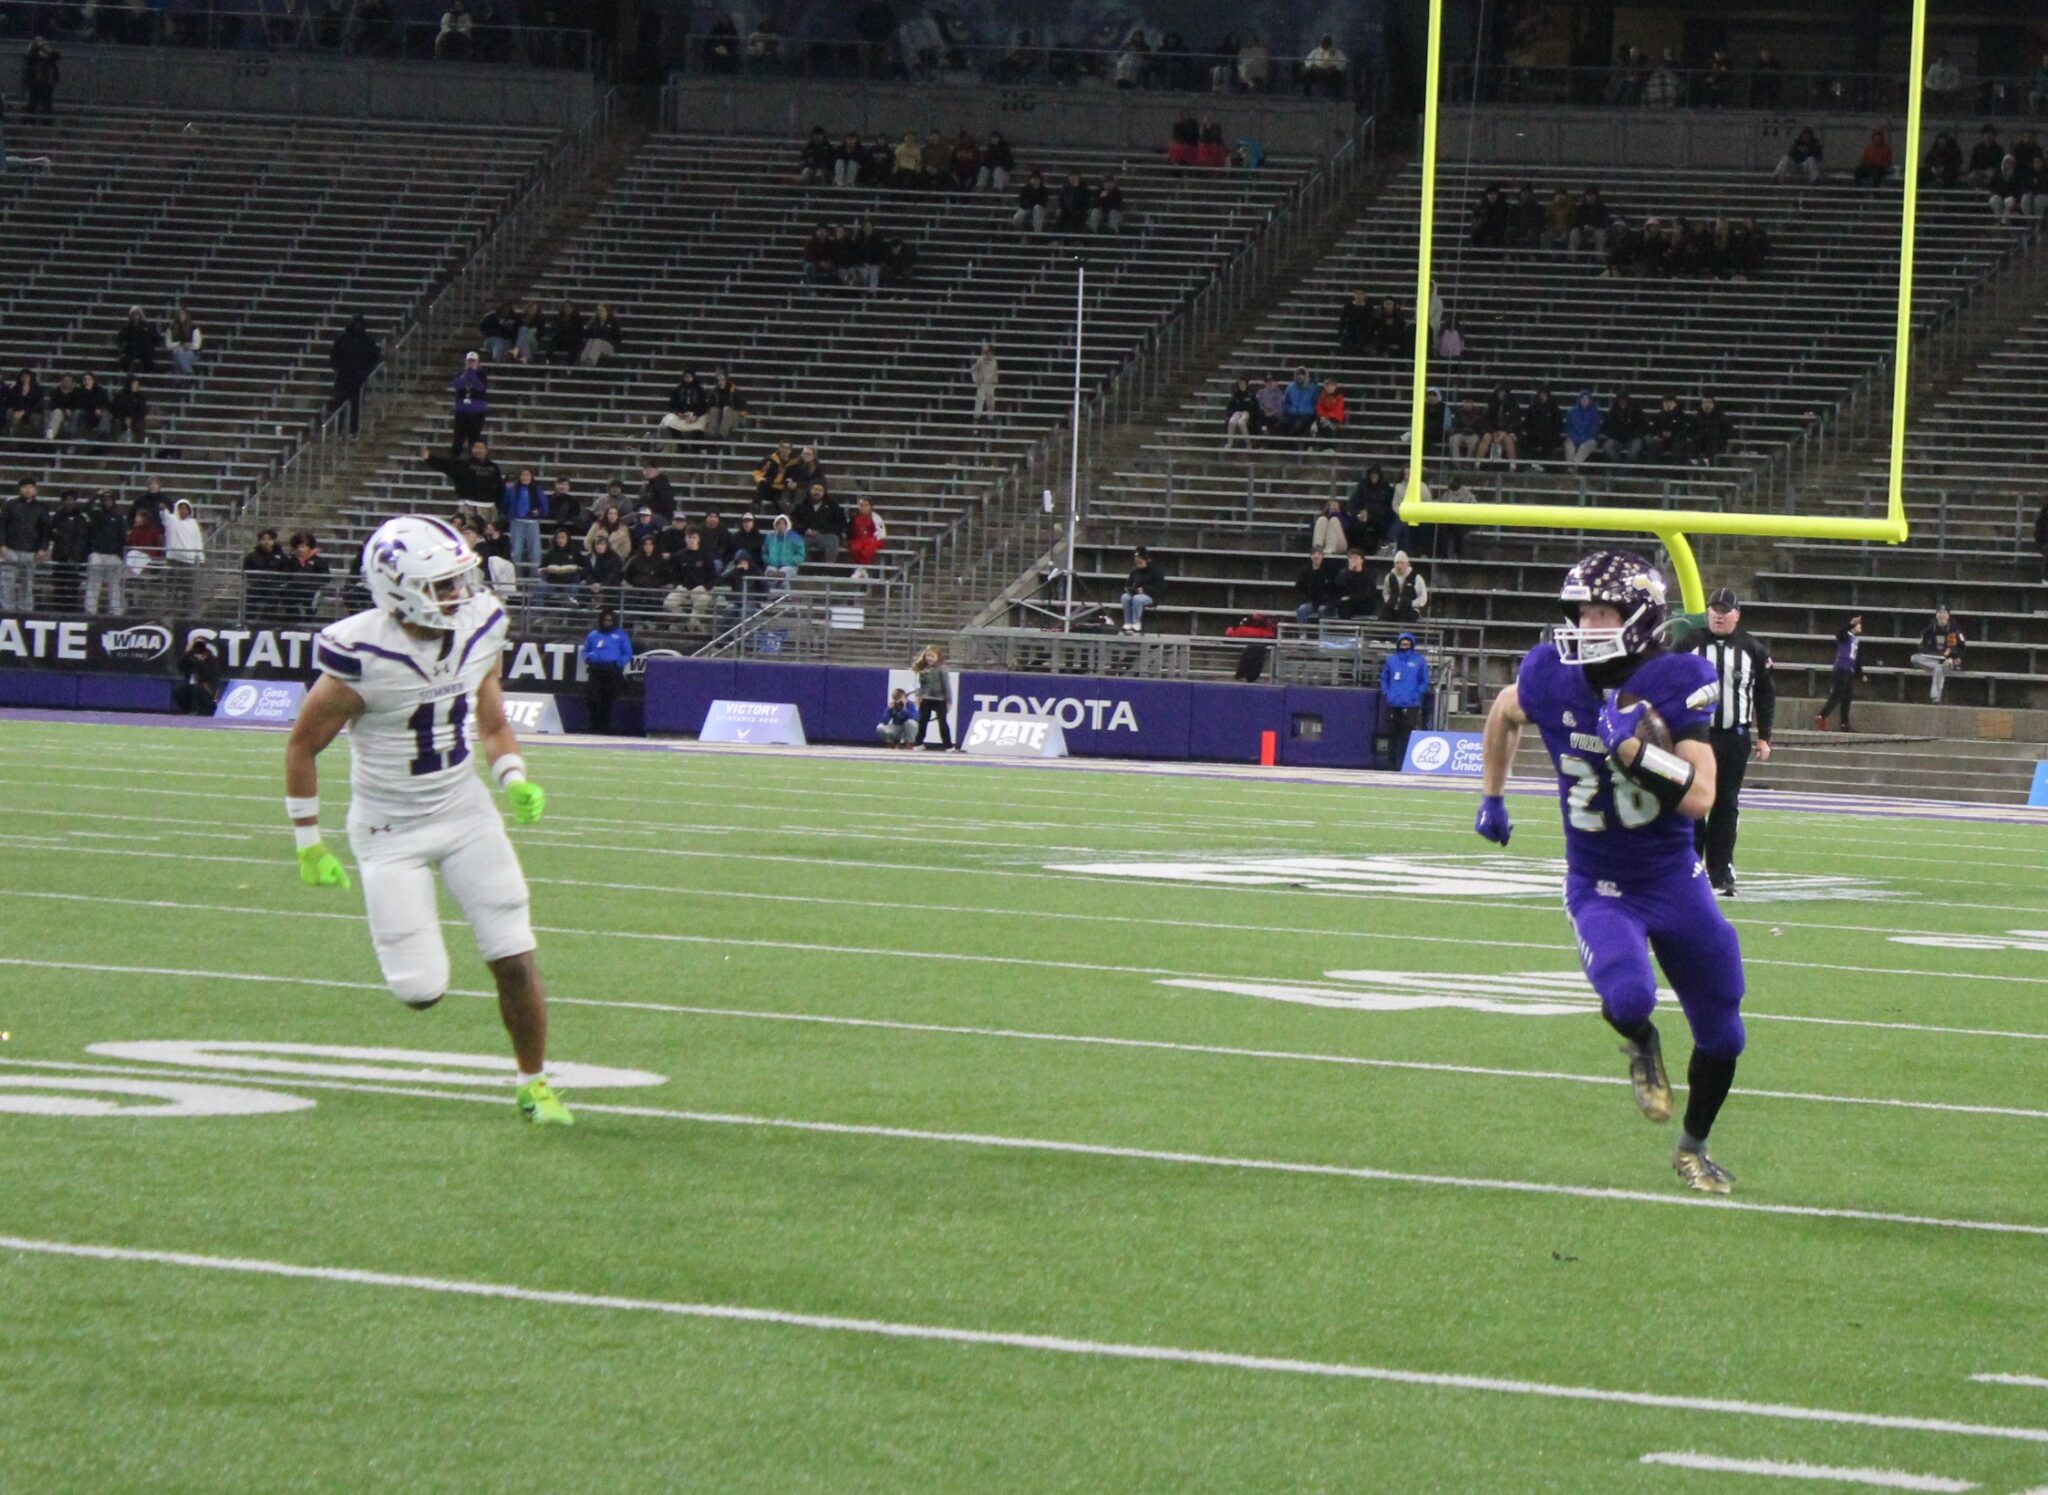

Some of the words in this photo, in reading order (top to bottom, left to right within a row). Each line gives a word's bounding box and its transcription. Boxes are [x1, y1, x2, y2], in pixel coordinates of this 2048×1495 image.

[113, 632, 161, 650] WIAA
[187, 628, 320, 670] STAT
[262, 687, 289, 697] Gesa
[418, 683, 465, 700] SUMNER
[258, 696, 291, 708] Credit
[726, 703, 779, 716] VICTORY
[254, 706, 283, 717] Union
[973, 694, 1139, 732] TOYOTA
[407, 693, 470, 776] 11
[969, 718, 1049, 750] STATE
[1456, 739, 1484, 751] Ges
